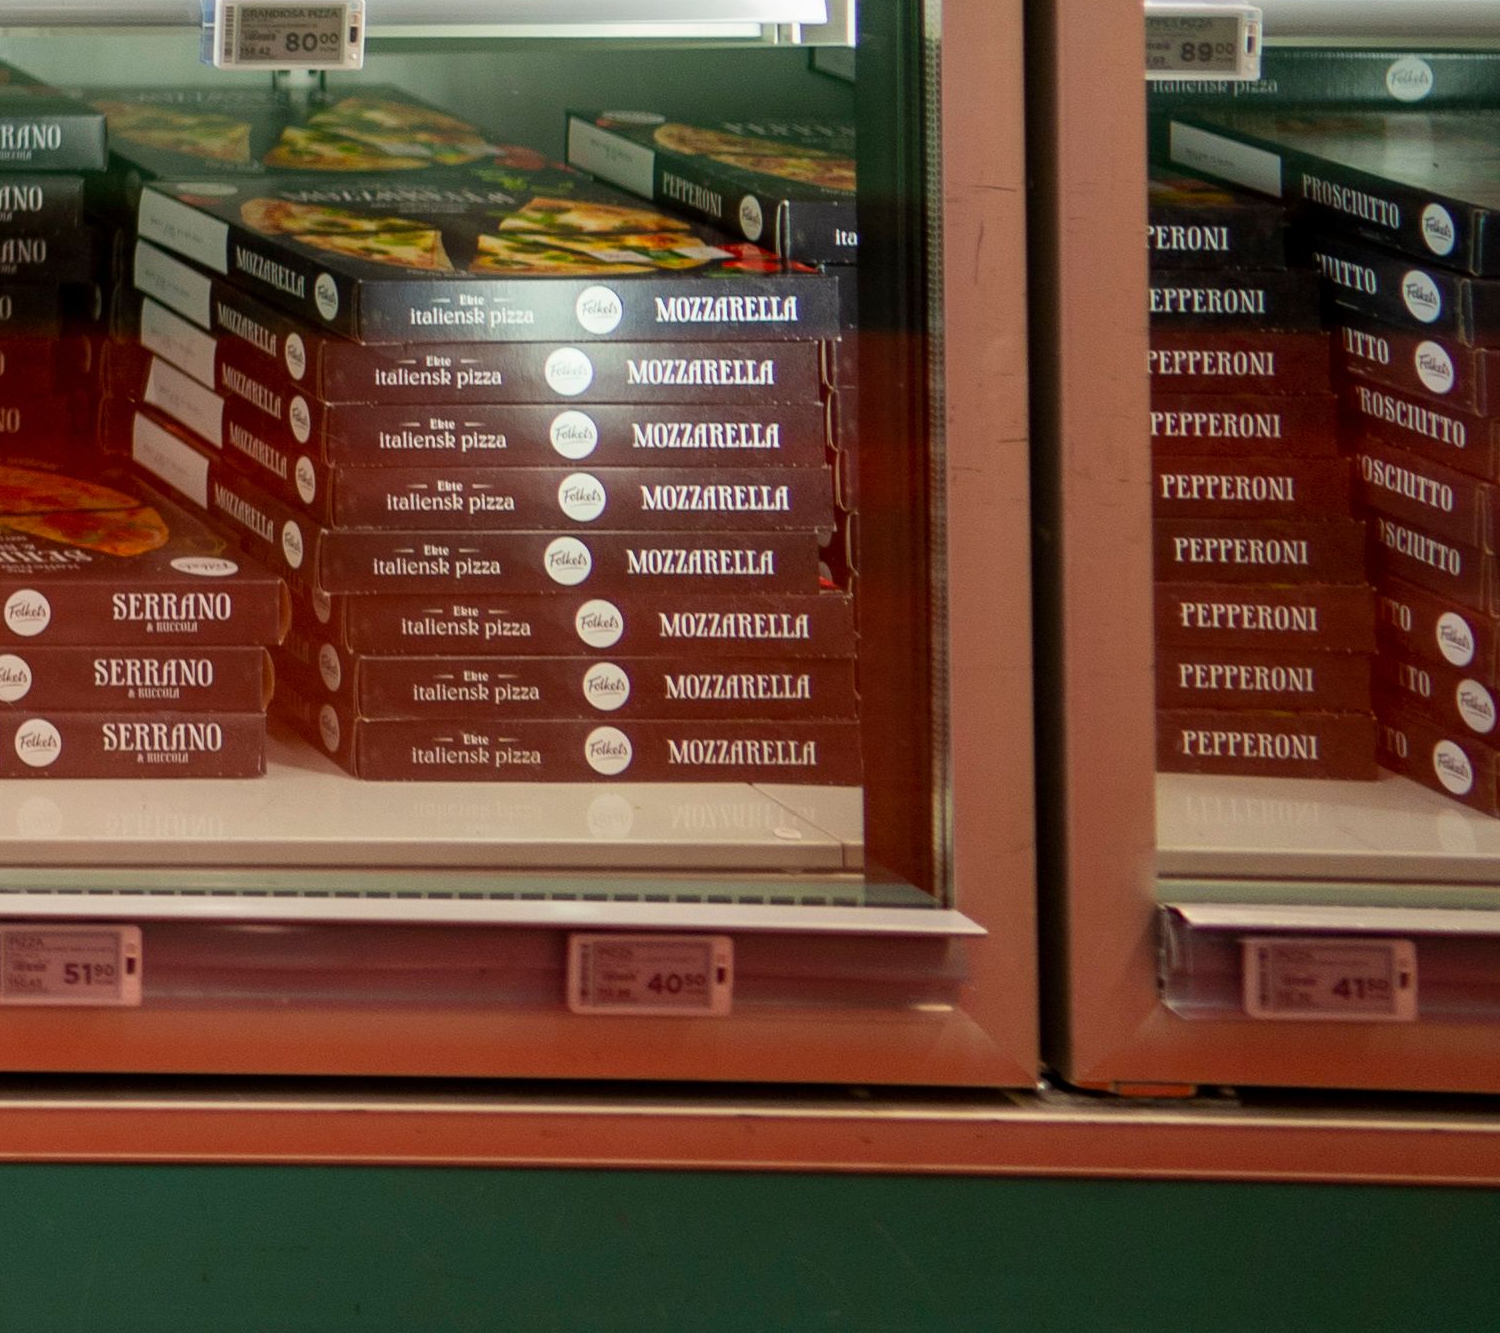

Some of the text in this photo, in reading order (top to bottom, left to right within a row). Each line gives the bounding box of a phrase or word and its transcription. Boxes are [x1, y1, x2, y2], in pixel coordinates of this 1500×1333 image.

[1302, 172, 1402, 232] PROSCIUTTO
[409, 306, 535, 328] italiensk pizza
[581, 295, 798, 322] Folkets MOZZARELLA
[1173, 537, 1310, 566] PEPPERONI
[112, 592, 232, 621] SERRANO
